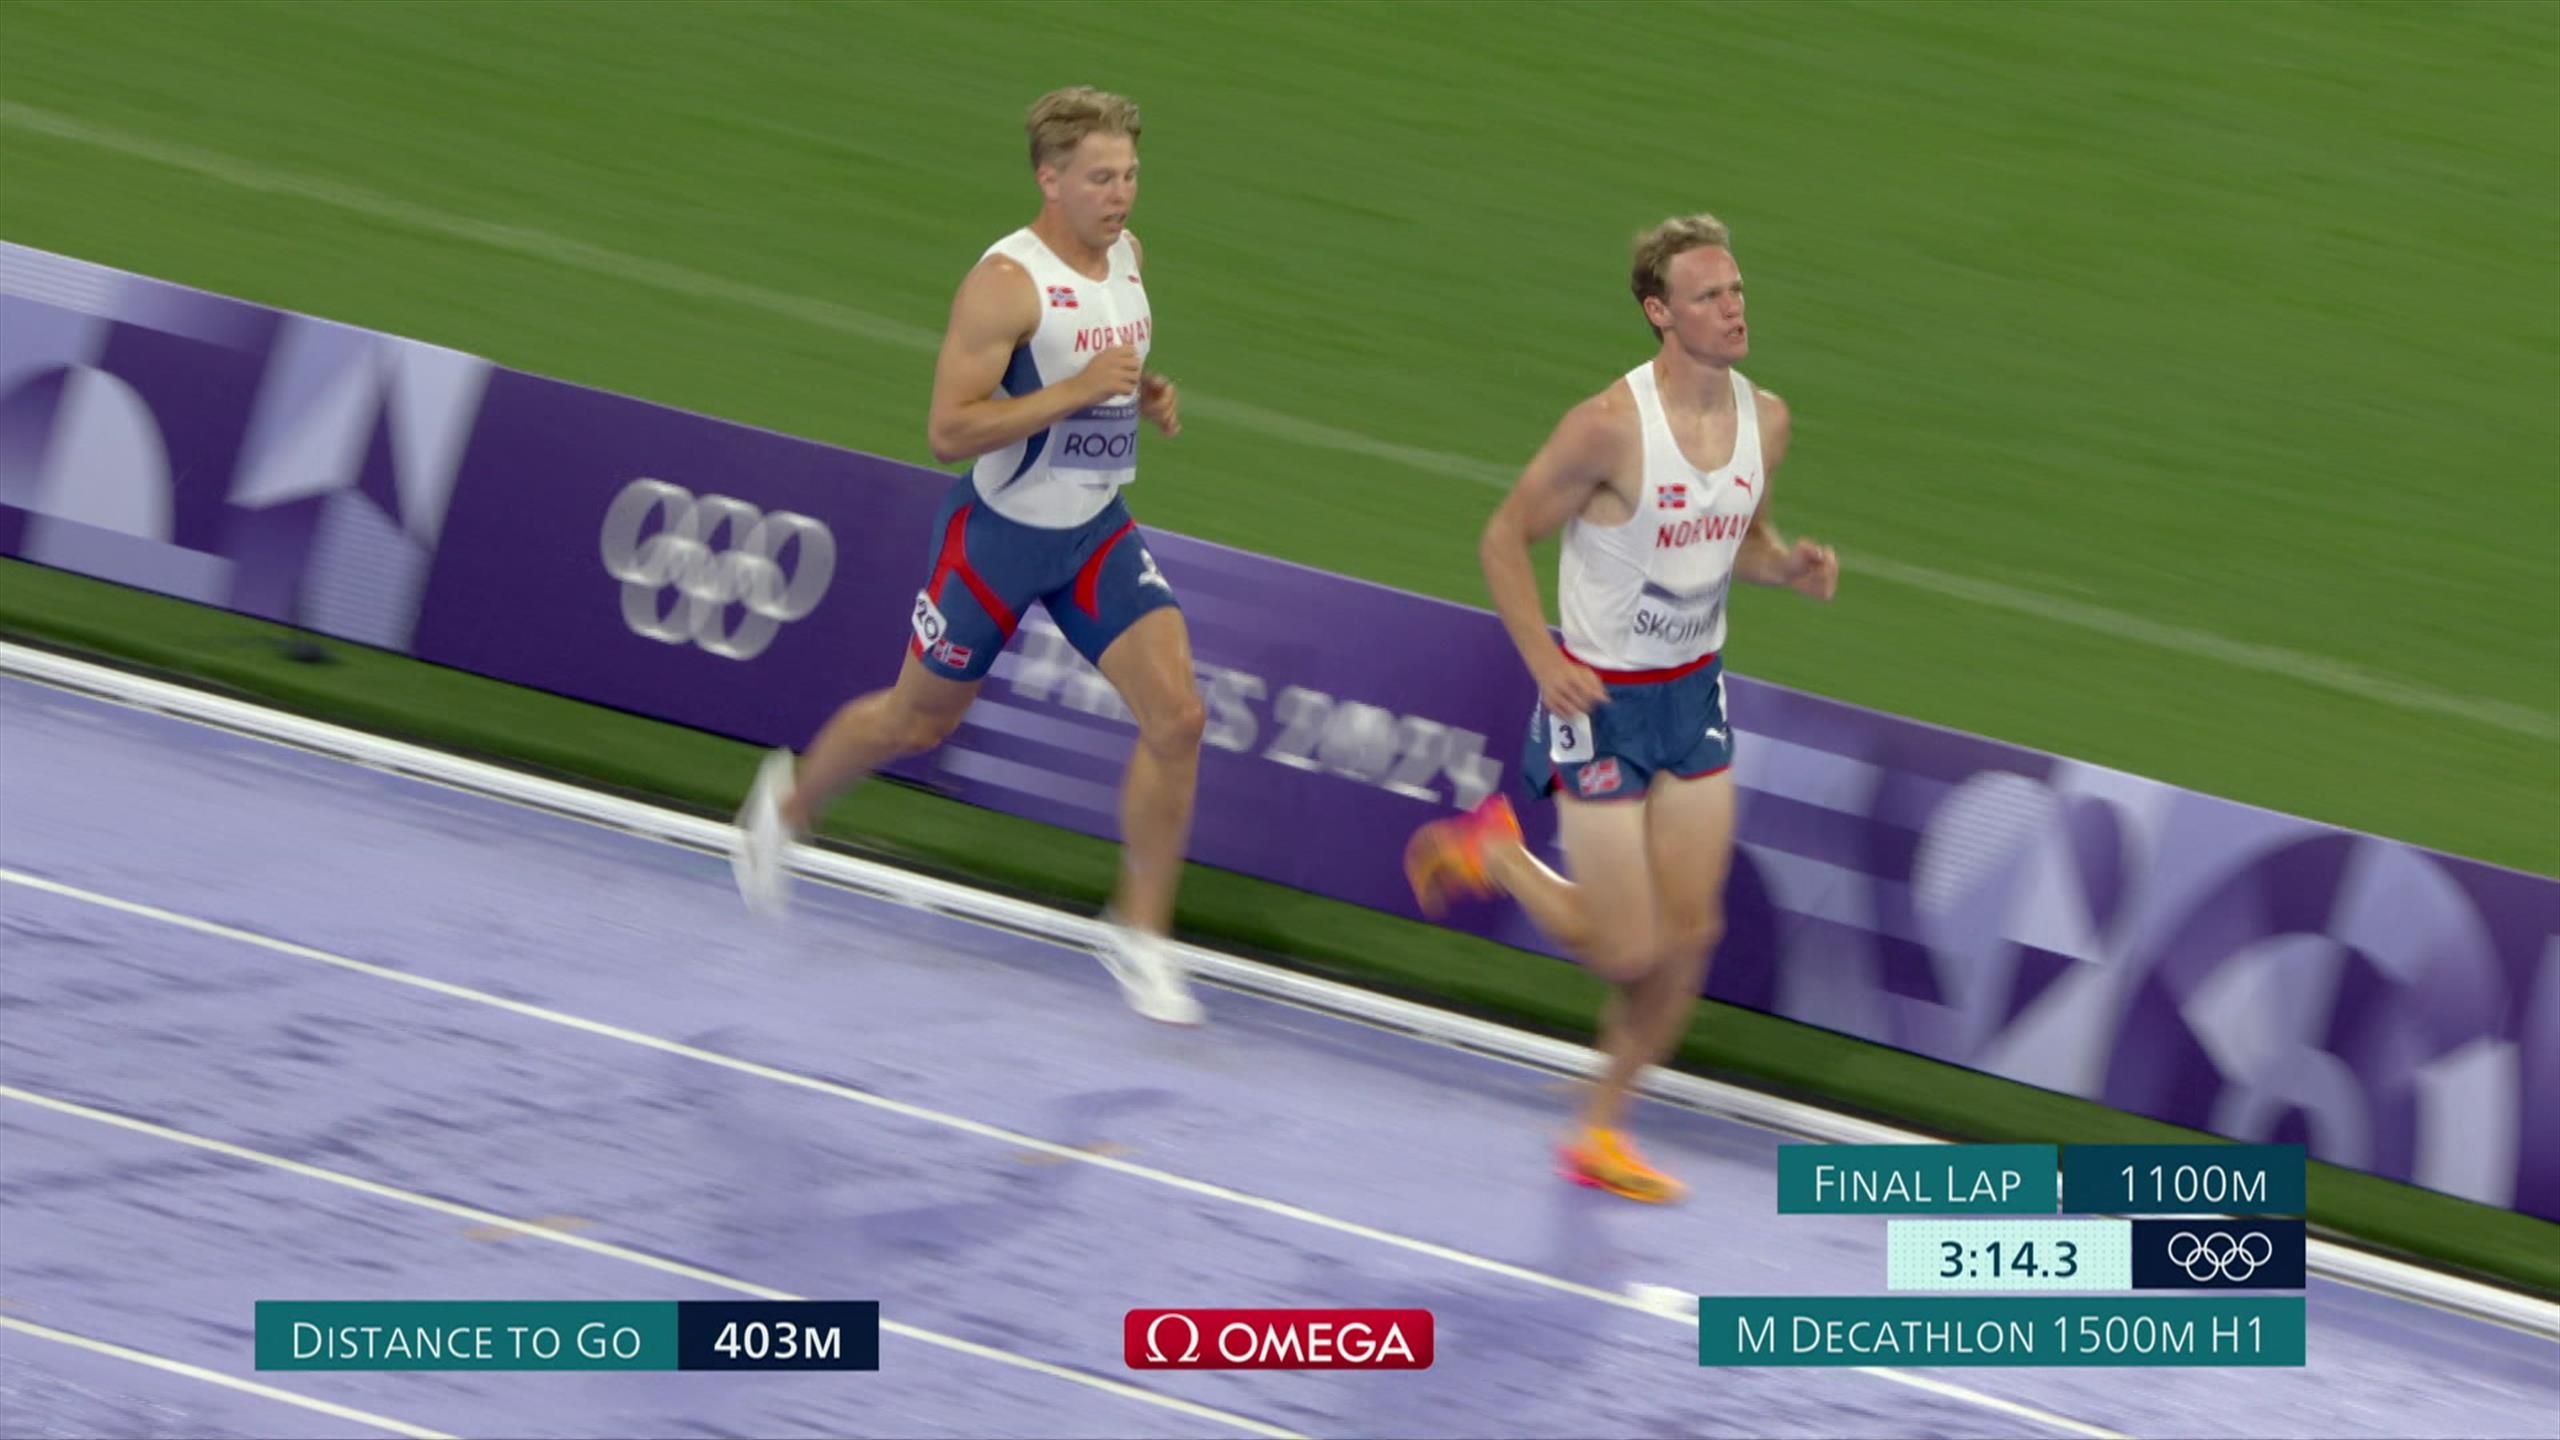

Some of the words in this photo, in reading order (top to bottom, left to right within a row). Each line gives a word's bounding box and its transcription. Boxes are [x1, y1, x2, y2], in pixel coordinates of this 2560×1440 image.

[1074, 316, 1151, 352] NORWAY
[1064, 430, 1137, 458] ROOT
[1655, 513, 1750, 549] NORWAY
[917, 599, 939, 641] 20
[1559, 725, 1576, 749] 3
